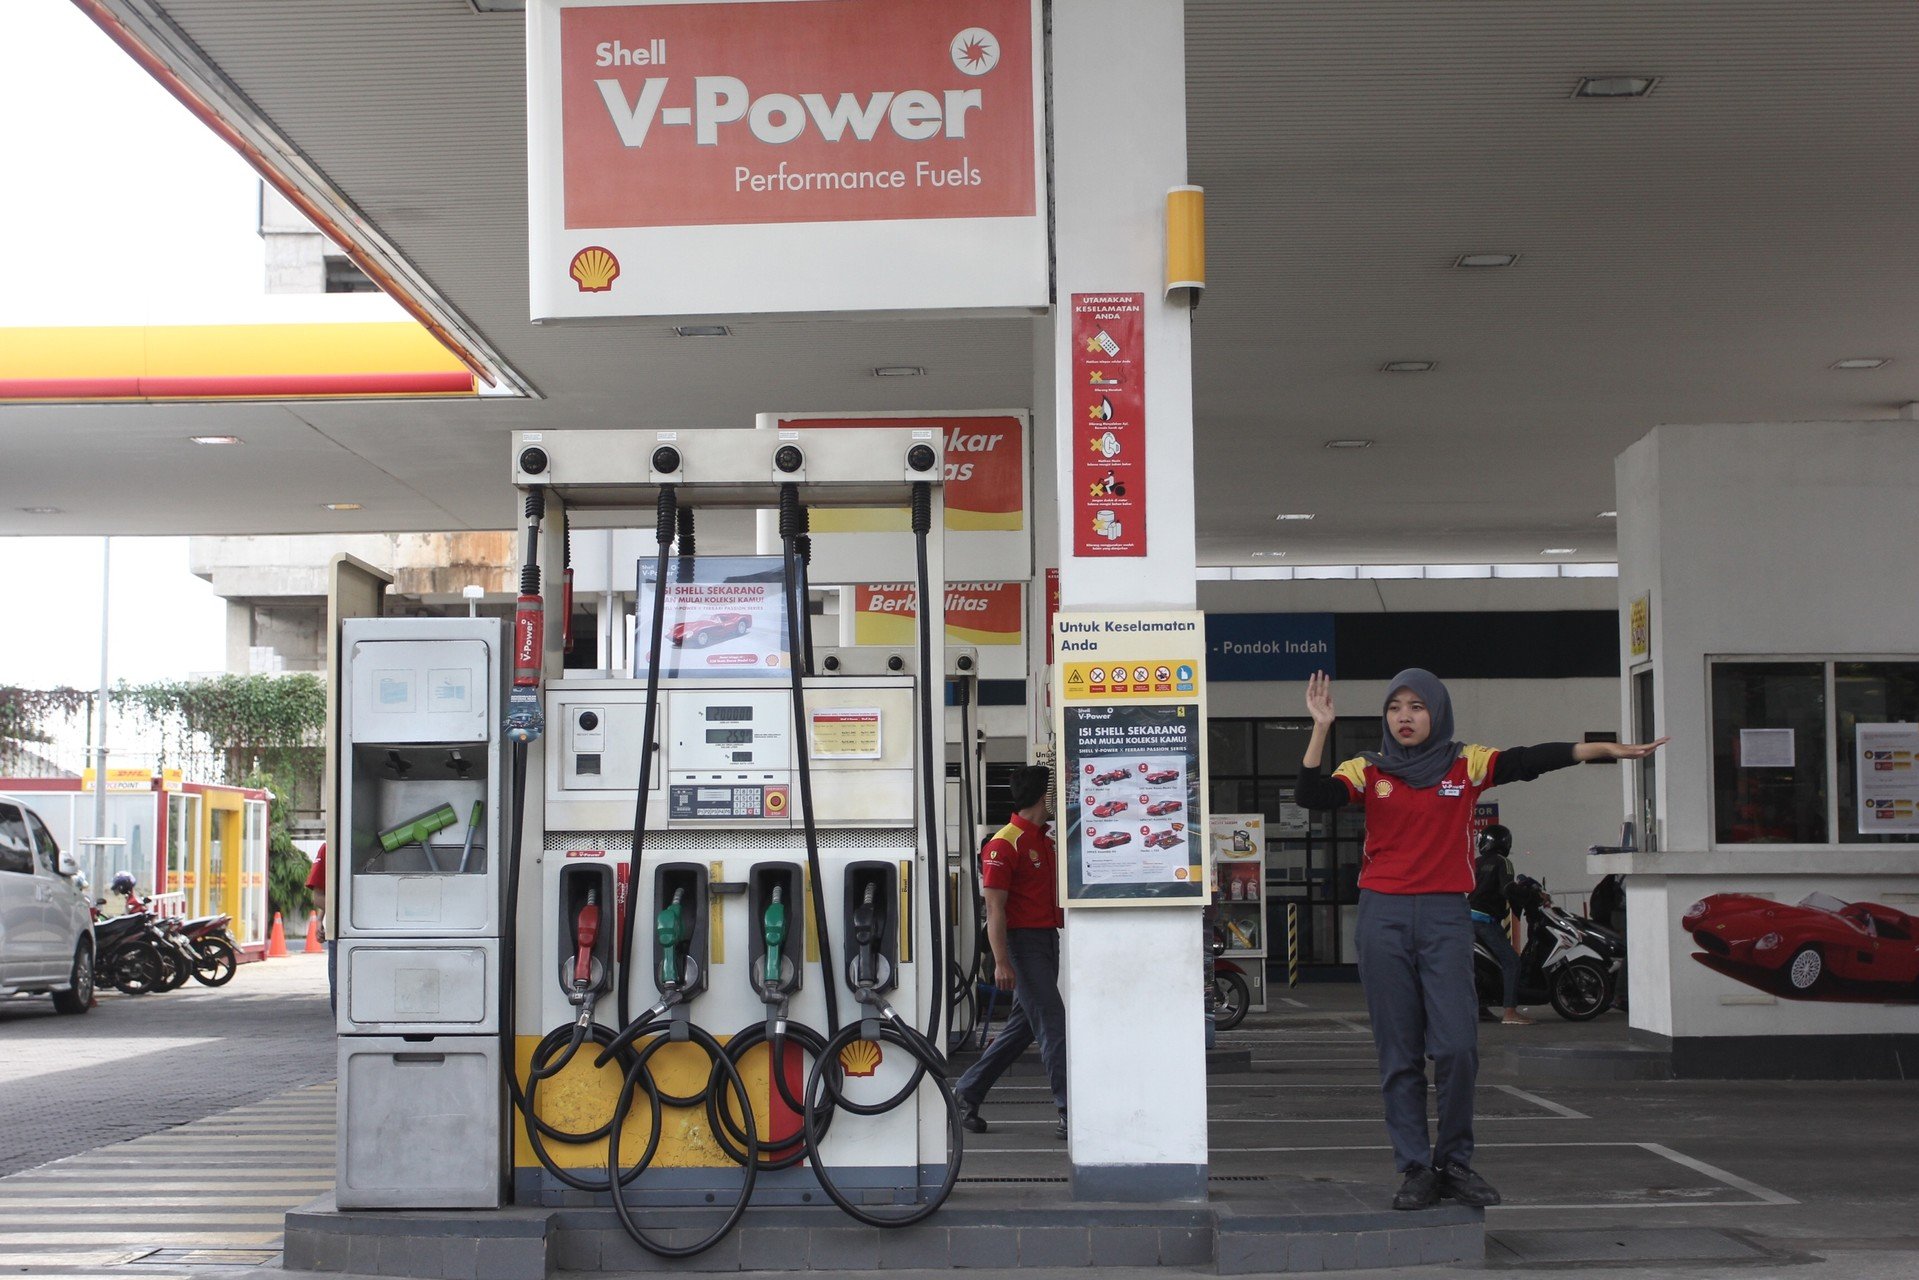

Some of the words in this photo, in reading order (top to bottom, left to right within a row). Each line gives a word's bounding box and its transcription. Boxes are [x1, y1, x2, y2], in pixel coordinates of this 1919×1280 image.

[595, 39, 666, 67] Shell
[594, 75, 983, 148] V-Power
[735, 161, 906, 192] Performance
[916, 156, 982, 187] Fuels
[944, 428, 1004, 452] kar
[675, 586, 704, 594] SHELL
[707, 586, 764, 594] SEKARANG
[868, 594, 988, 611] Berklitas
[1060, 621, 1100, 633] Untuk
[1105, 620, 1195, 632] Keselamatan
[523, 622, 534, 662] V-Power
[1061, 639, 1098, 651] Anda
[1224, 641, 1280, 654] Pondok
[1285, 640, 1327, 653] Indah
[1079, 728, 1092, 736] ISI
[1095, 727, 1125, 736] SHELL
[1128, 725, 1186, 735] SEKARANG
